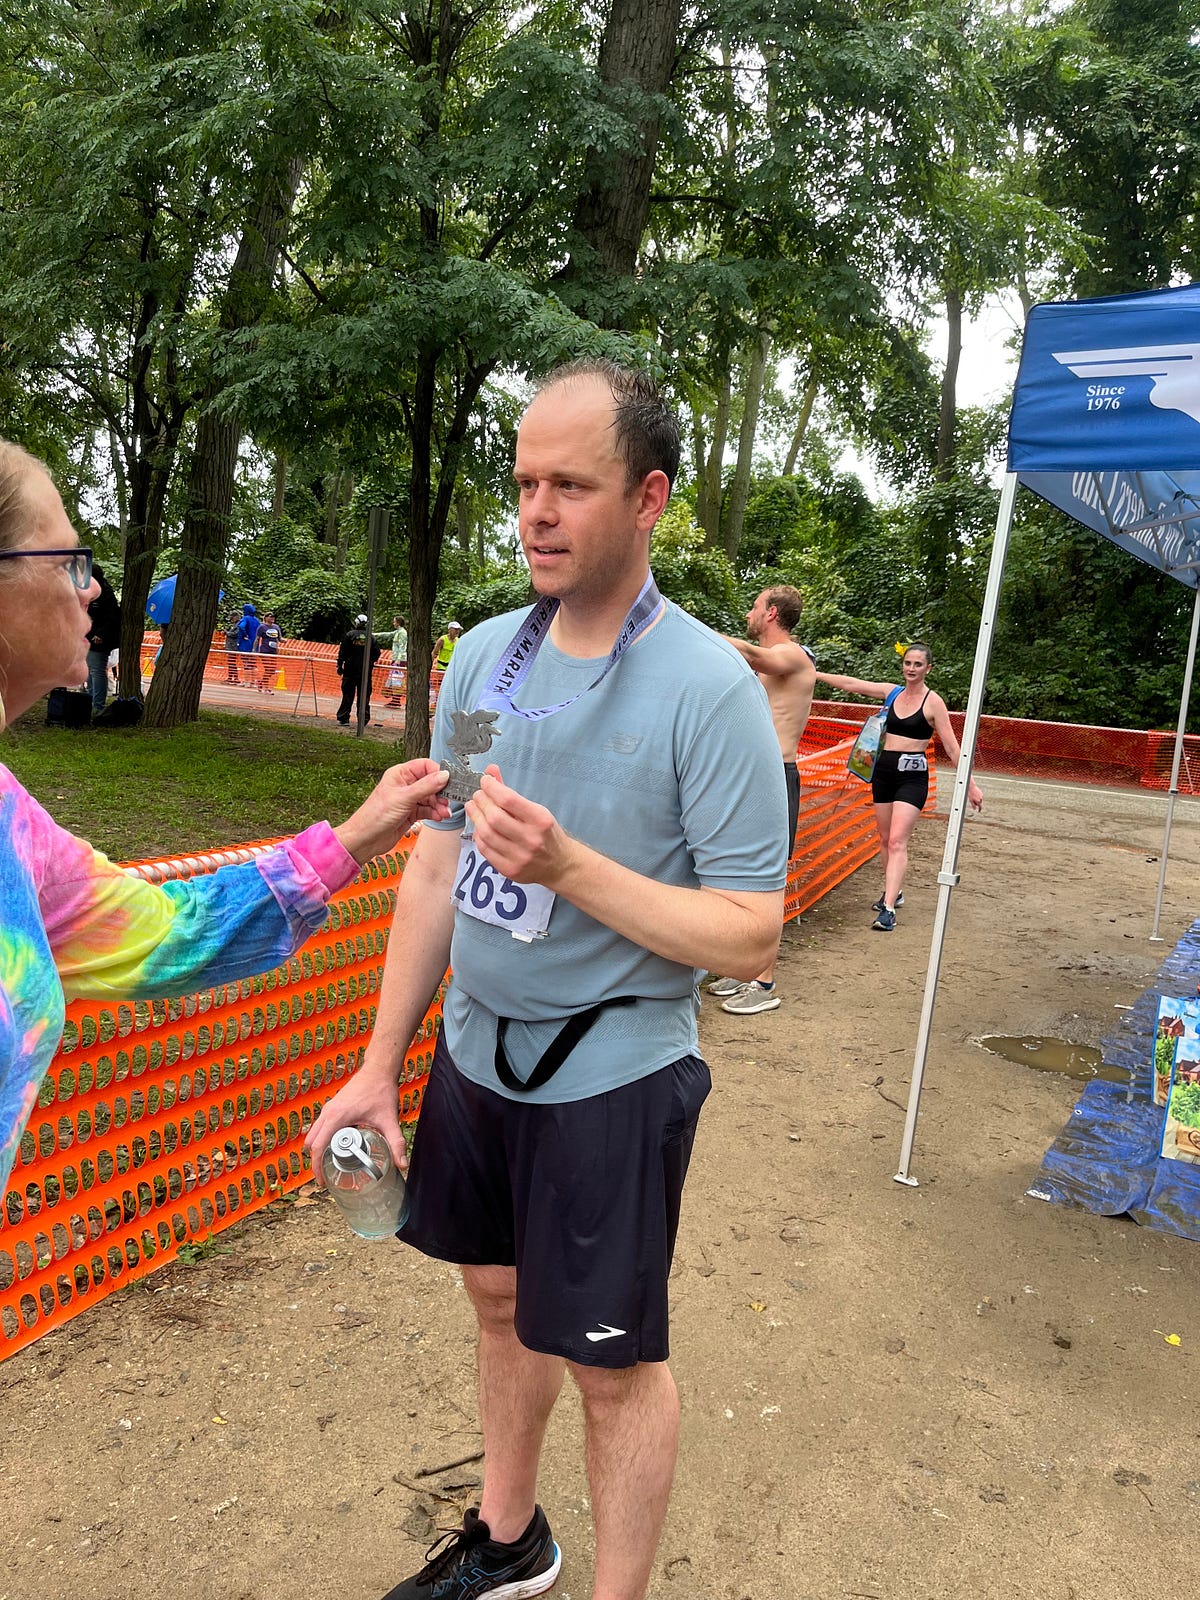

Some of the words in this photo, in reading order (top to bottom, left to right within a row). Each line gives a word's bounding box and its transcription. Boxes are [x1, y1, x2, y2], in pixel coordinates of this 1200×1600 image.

[1086, 385, 1126, 397] Since
[1087, 396, 1120, 411] 1976
[529, 598, 553, 637] ERIE
[455, 850, 528, 921] 265
